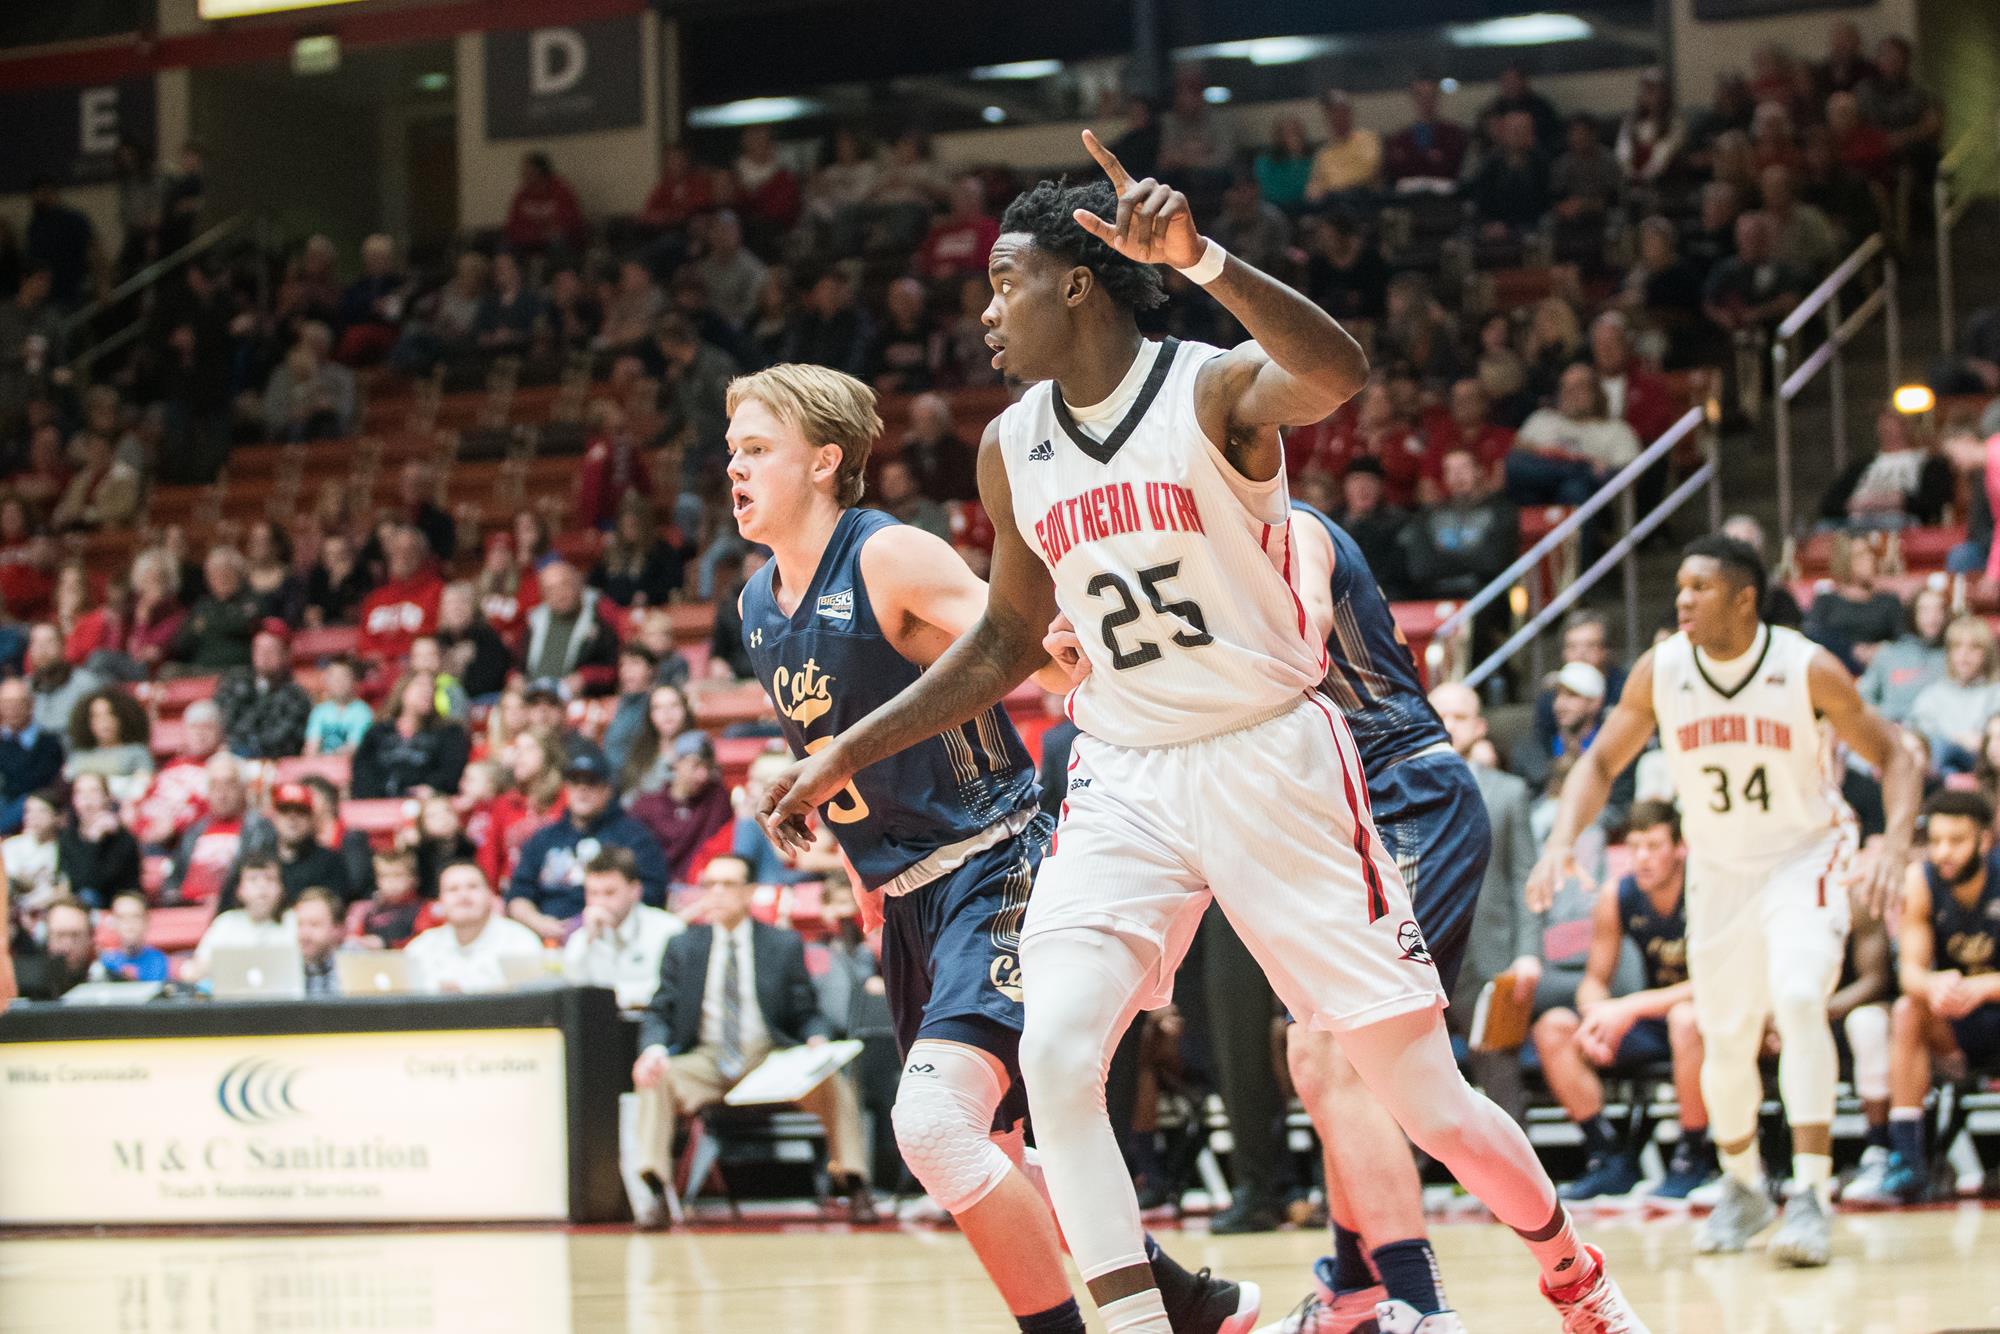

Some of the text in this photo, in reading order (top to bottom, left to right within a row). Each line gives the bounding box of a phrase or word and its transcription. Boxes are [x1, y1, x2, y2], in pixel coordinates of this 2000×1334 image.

[529, 28, 587, 94] D
[80, 88, 119, 152] E
[1035, 481, 1206, 569] SOUTHERN UTAH
[1087, 560, 1215, 670] 25
[773, 658, 833, 718] Cats
[1702, 766, 1770, 812] 34
[990, 955, 1022, 987] Ca
[112, 1131, 430, 1172] M & C Sanitation
